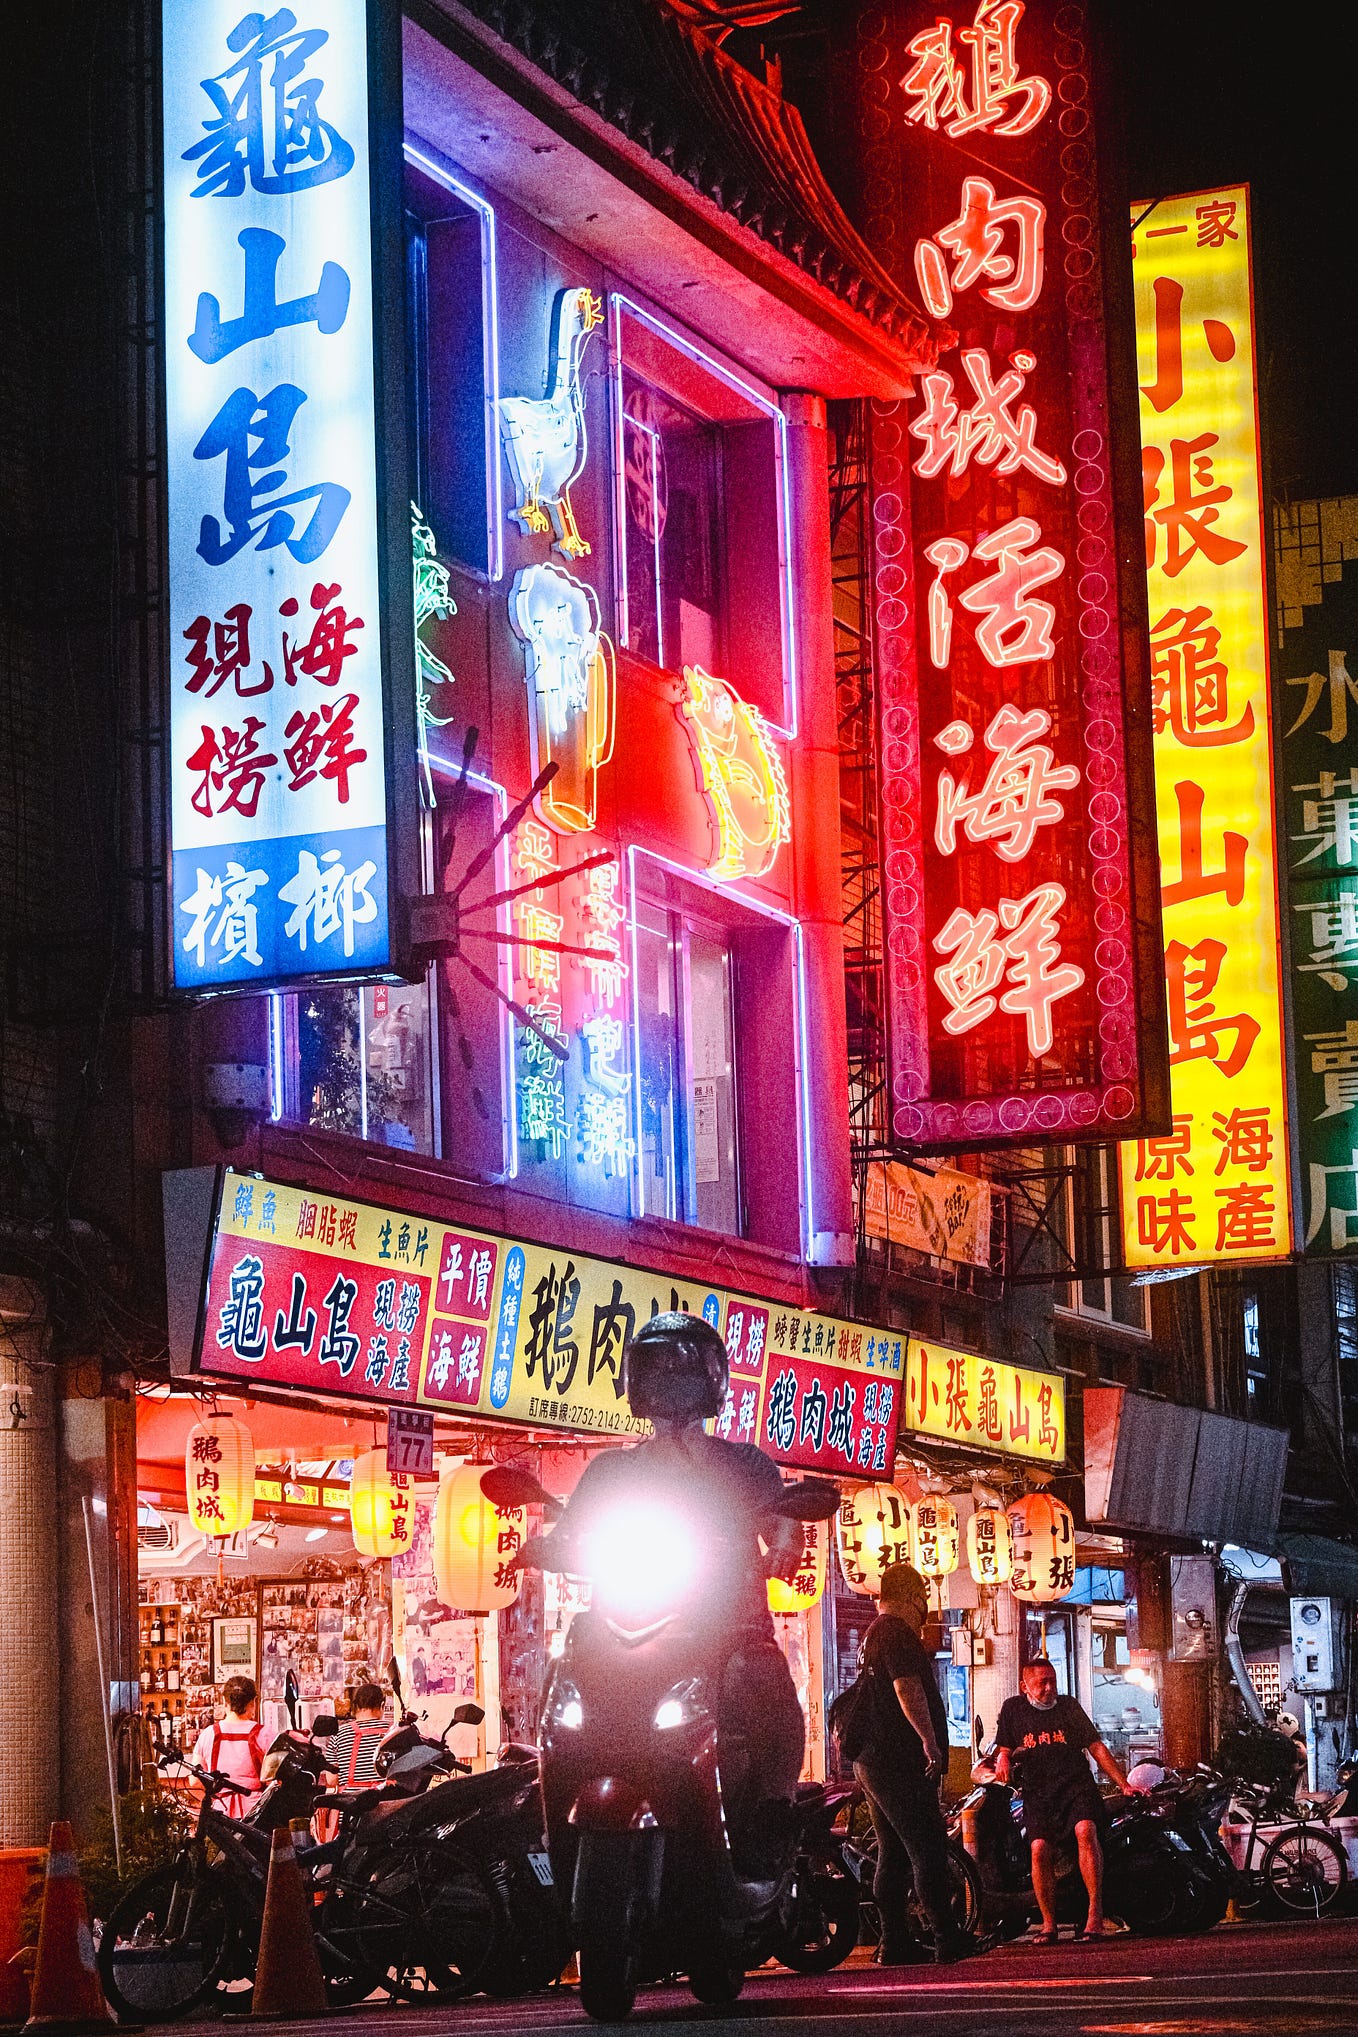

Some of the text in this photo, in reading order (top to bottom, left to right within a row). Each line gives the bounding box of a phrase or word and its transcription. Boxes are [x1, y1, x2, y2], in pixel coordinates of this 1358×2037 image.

[181, 7, 355, 565] 龜山島
[182, 603, 278, 818] 現撈
[278, 582, 368, 805] 海鮮
[180, 849, 379, 968] 檳榔
[1134, 1112, 1197, 1256] 原味
[1212, 1106, 1277, 1252] 海產
[232, 1182, 277, 1236] 鮮魚
[295, 1199, 359, 1251] 胭脂蝦
[377, 1218, 430, 1268] 生魚片
[440, 1242, 493, 1311] 平價
[216, 1253, 361, 1377] 龜山島
[372, 1278, 422, 1336] 現撈
[490, 1256, 522, 1402] 純種土鵝
[774, 1313, 801, 1352] 螃蟹
[365, 1335, 411, 1391] 海產
[428, 1330, 481, 1396] 海鮮
[725, 1311, 766, 1368] 現撈
[801, 1320, 836, 1359] 生魚片
[838, 1328, 863, 1364] 甜蝦
[866, 1334, 901, 1372] 生啤酒
[716, 1386, 757, 1443] 海鮮
[766, 1367, 856, 1462] 鵝肉城
[863, 1379, 894, 1427] 現撈
[911, 1347, 1060, 1455] 小張龜山島
[192, 1435, 225, 1521] 鵝肉城
[400, 1436, 425, 1467] 77
[858, 1427, 887, 1471] 海產
[918, 1506, 940, 1567] 龜山島
[975, 1518, 999, 1576] 龜山島
[1048, 1513, 1075, 1589] 小張
[1023, 1730, 1067, 1748] 鵝肉城
